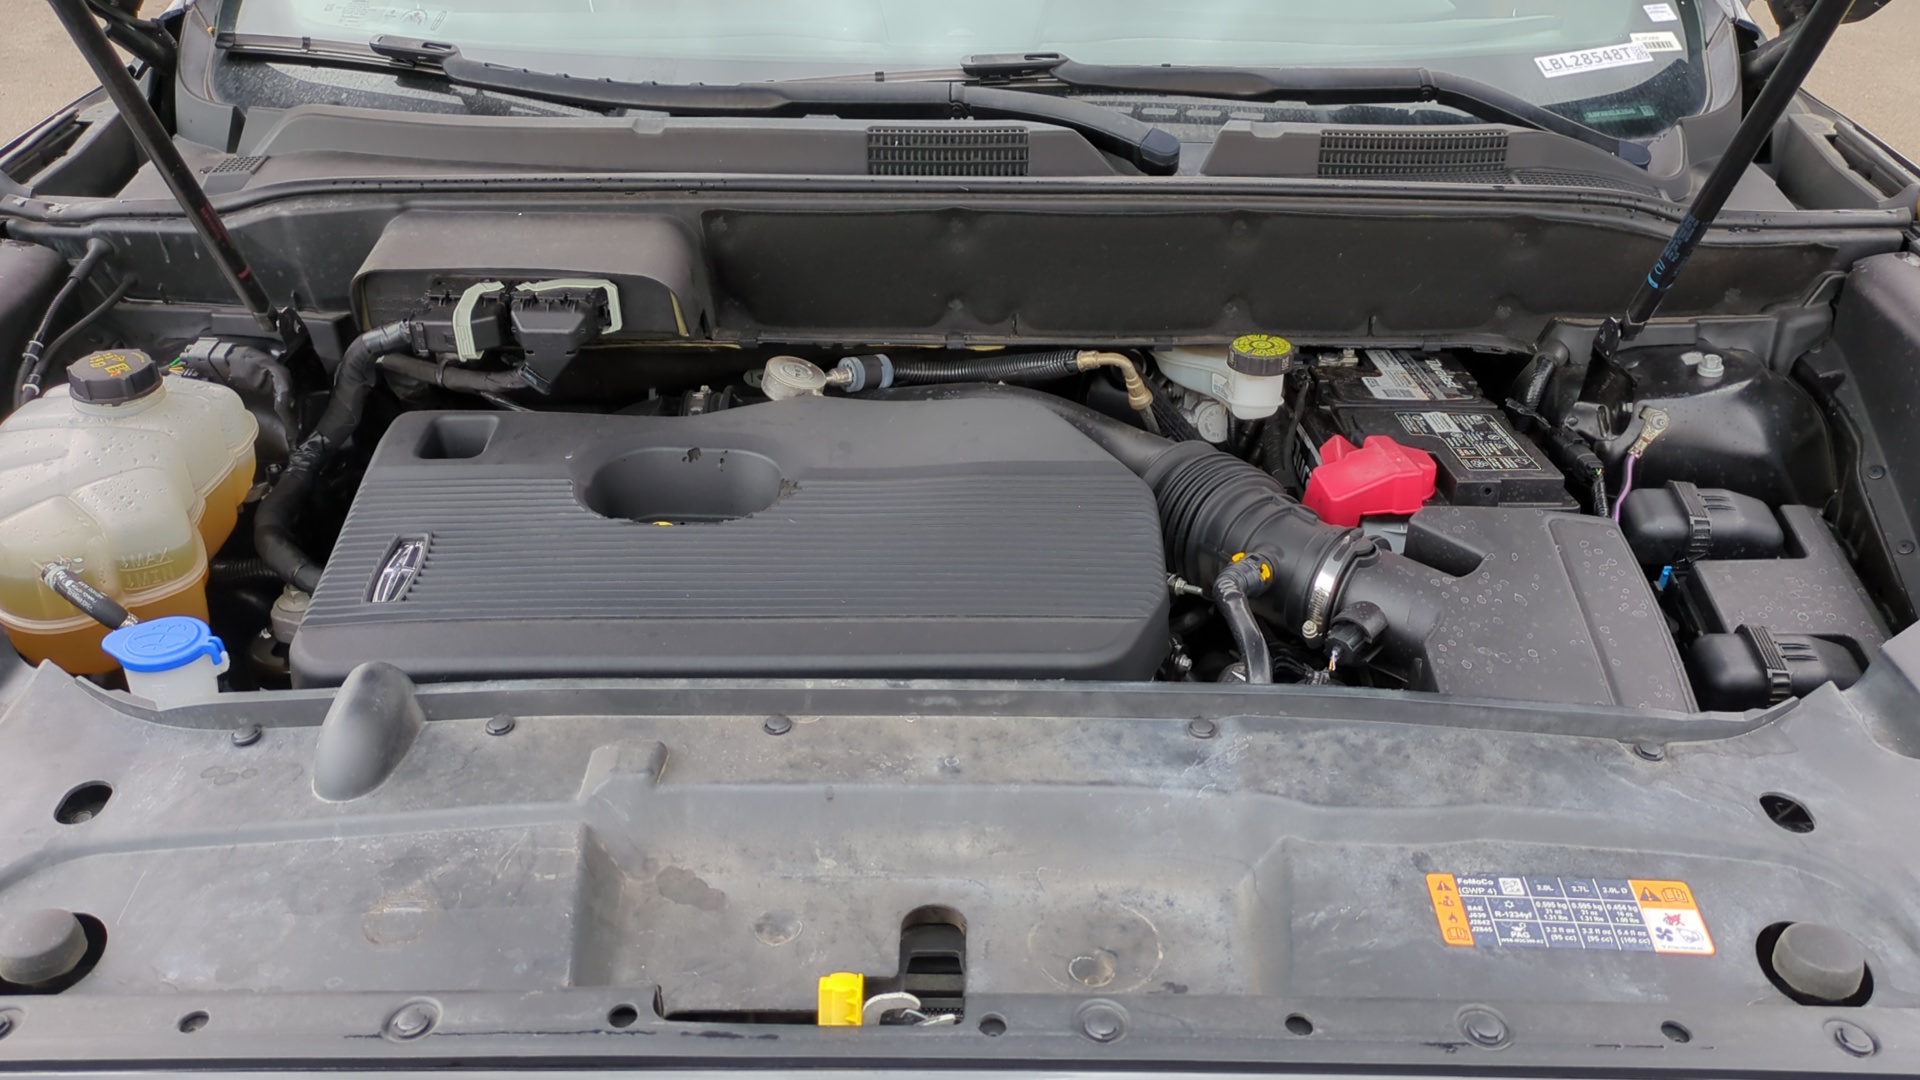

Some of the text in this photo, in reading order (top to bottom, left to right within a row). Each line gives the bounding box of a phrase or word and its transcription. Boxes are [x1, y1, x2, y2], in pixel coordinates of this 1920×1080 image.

[1539, 46, 1631, 73] LBL28548T
[132, 546, 171, 569] MAX
[137, 565, 175, 586] MIN
[1488, 888, 1497, 896] 4)
[1494, 911, 1532, 919] R-1234yf
